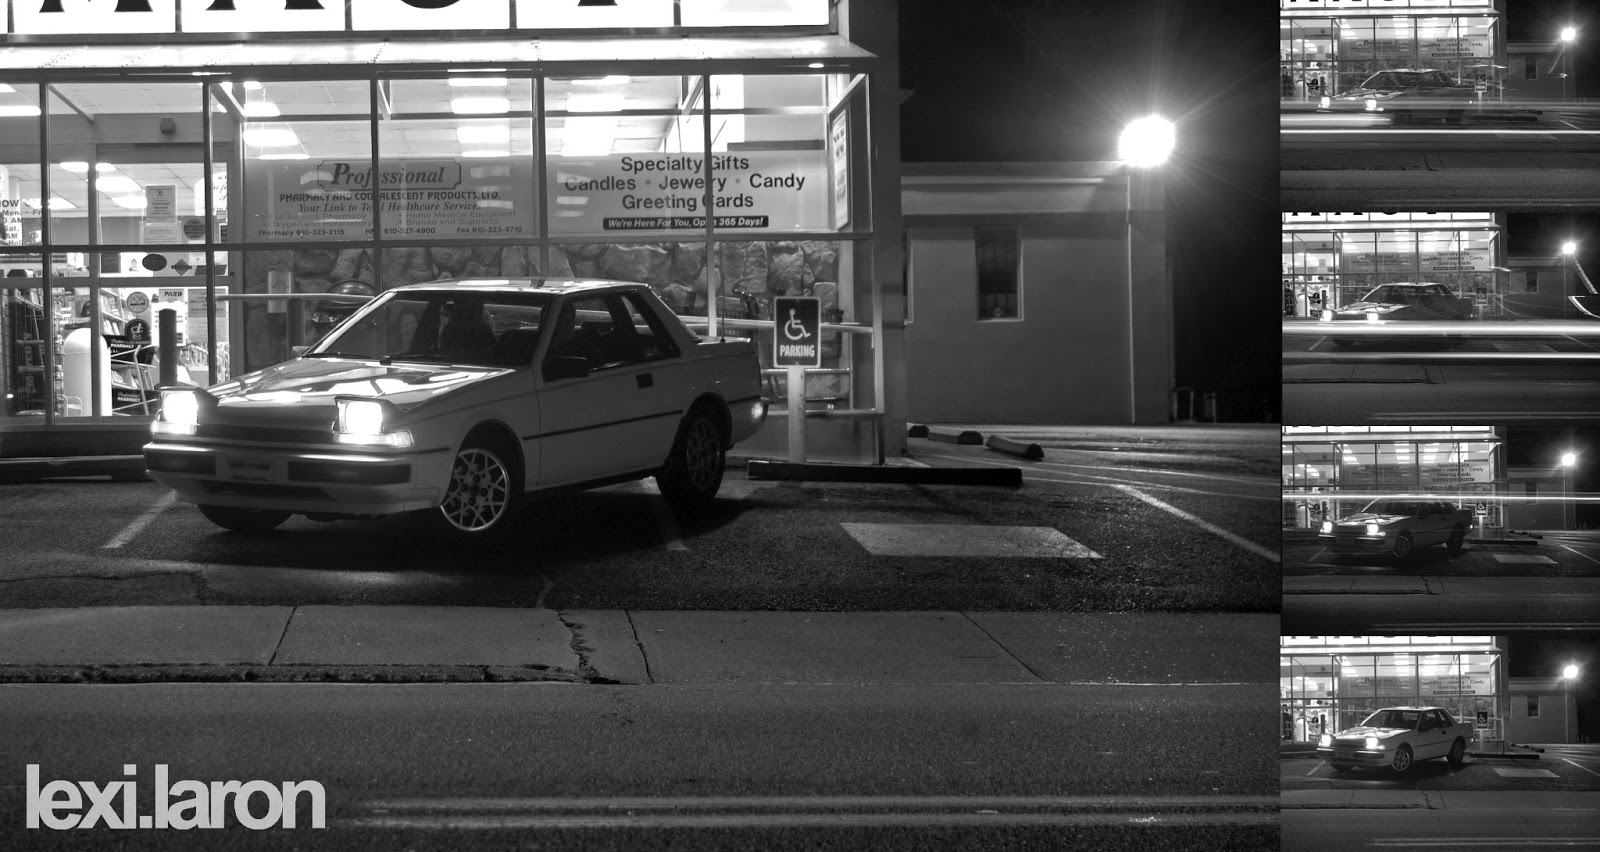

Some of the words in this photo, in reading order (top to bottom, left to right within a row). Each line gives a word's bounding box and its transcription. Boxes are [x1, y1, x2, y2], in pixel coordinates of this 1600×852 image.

[621, 156, 703, 174] Specialty
[711, 155, 749, 170] Gifts
[331, 162, 445, 188] Profssional
[564, 175, 637, 191] Candles
[658, 175, 727, 192] Jewey
[749, 173, 805, 191] Candy
[280, 193, 330, 202] PHARMACY
[333, 193, 352, 201] AND
[354, 191, 425, 201] CONALESCENT
[622, 194, 697, 212] Greeting
[299, 203, 321, 212] Your
[323, 203, 346, 212] Link
[348, 204, 358, 212] to
[361, 202, 385, 212] Tol
[388, 202, 440, 211] Healthcare
[608, 219, 633, 227] We're
[634, 219, 655, 227] Here
[657, 219, 672, 227] For
[674, 218, 692, 228] You,
[692, 218, 717, 228] Opn
[719, 217, 736, 226] 365
[738, 217, 764, 227] Days!
[258, 229, 294, 237] Pharmacy
[780, 344, 815, 357] PARKING
